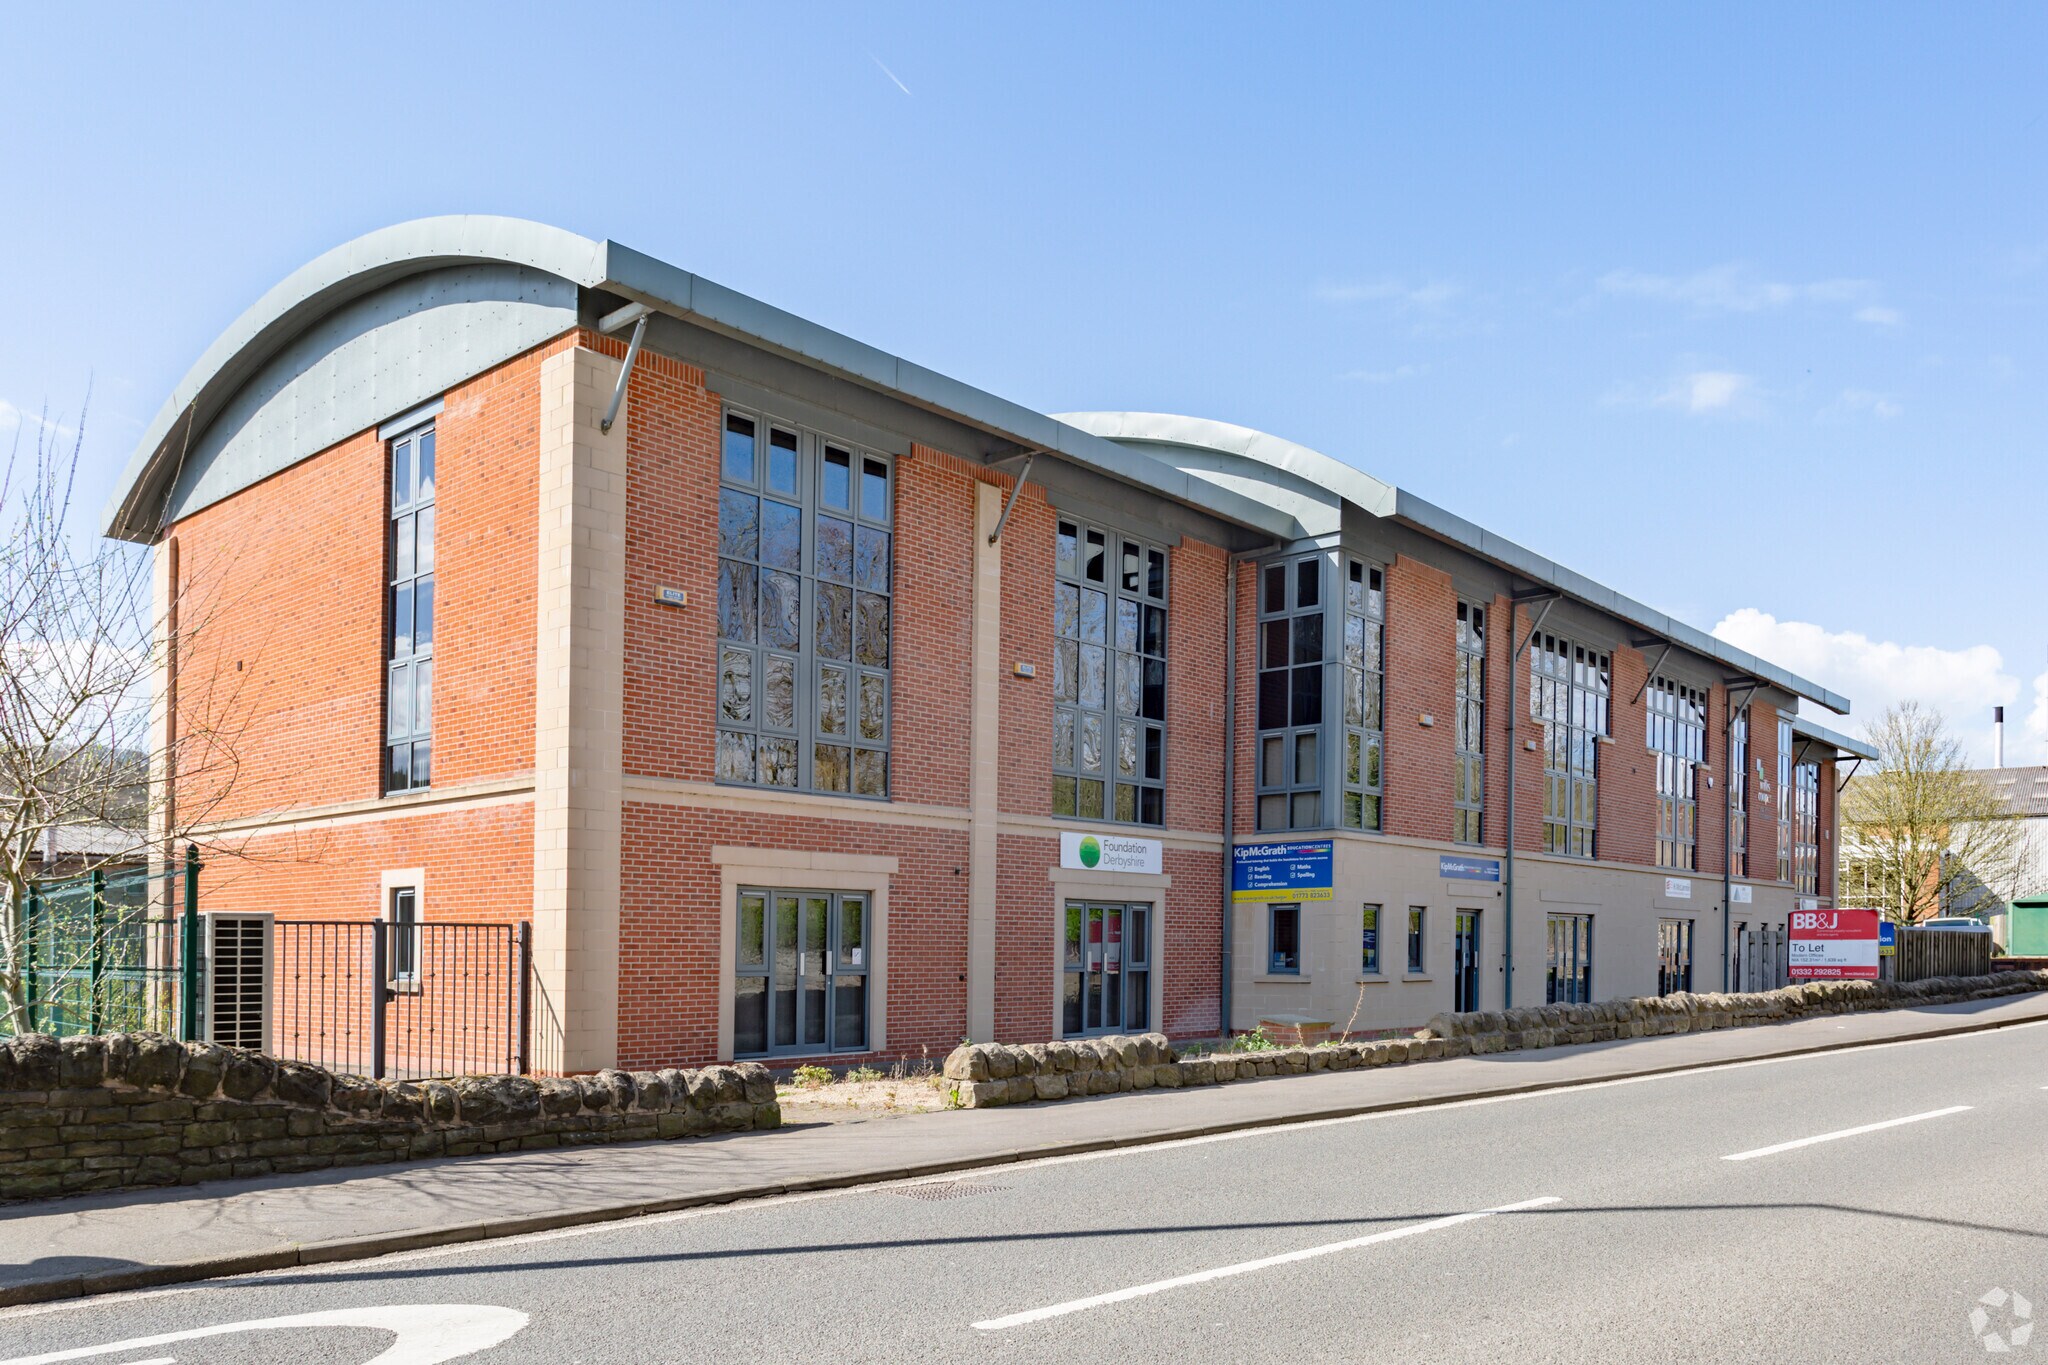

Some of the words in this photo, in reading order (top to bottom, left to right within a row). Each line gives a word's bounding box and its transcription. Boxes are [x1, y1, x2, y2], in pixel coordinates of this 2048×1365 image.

[1103, 839, 1147, 854] Foundation
[1234, 844, 1287, 860] KipMcGrath
[1103, 853, 1145, 869] Derbyshire
[1793, 912, 1838, 930] BB&J
[1792, 943, 1805, 952] To
[1808, 943, 1824, 952] Let
[1791, 968, 1812, 976] 01332
[1813, 968, 1841, 976] 292825
